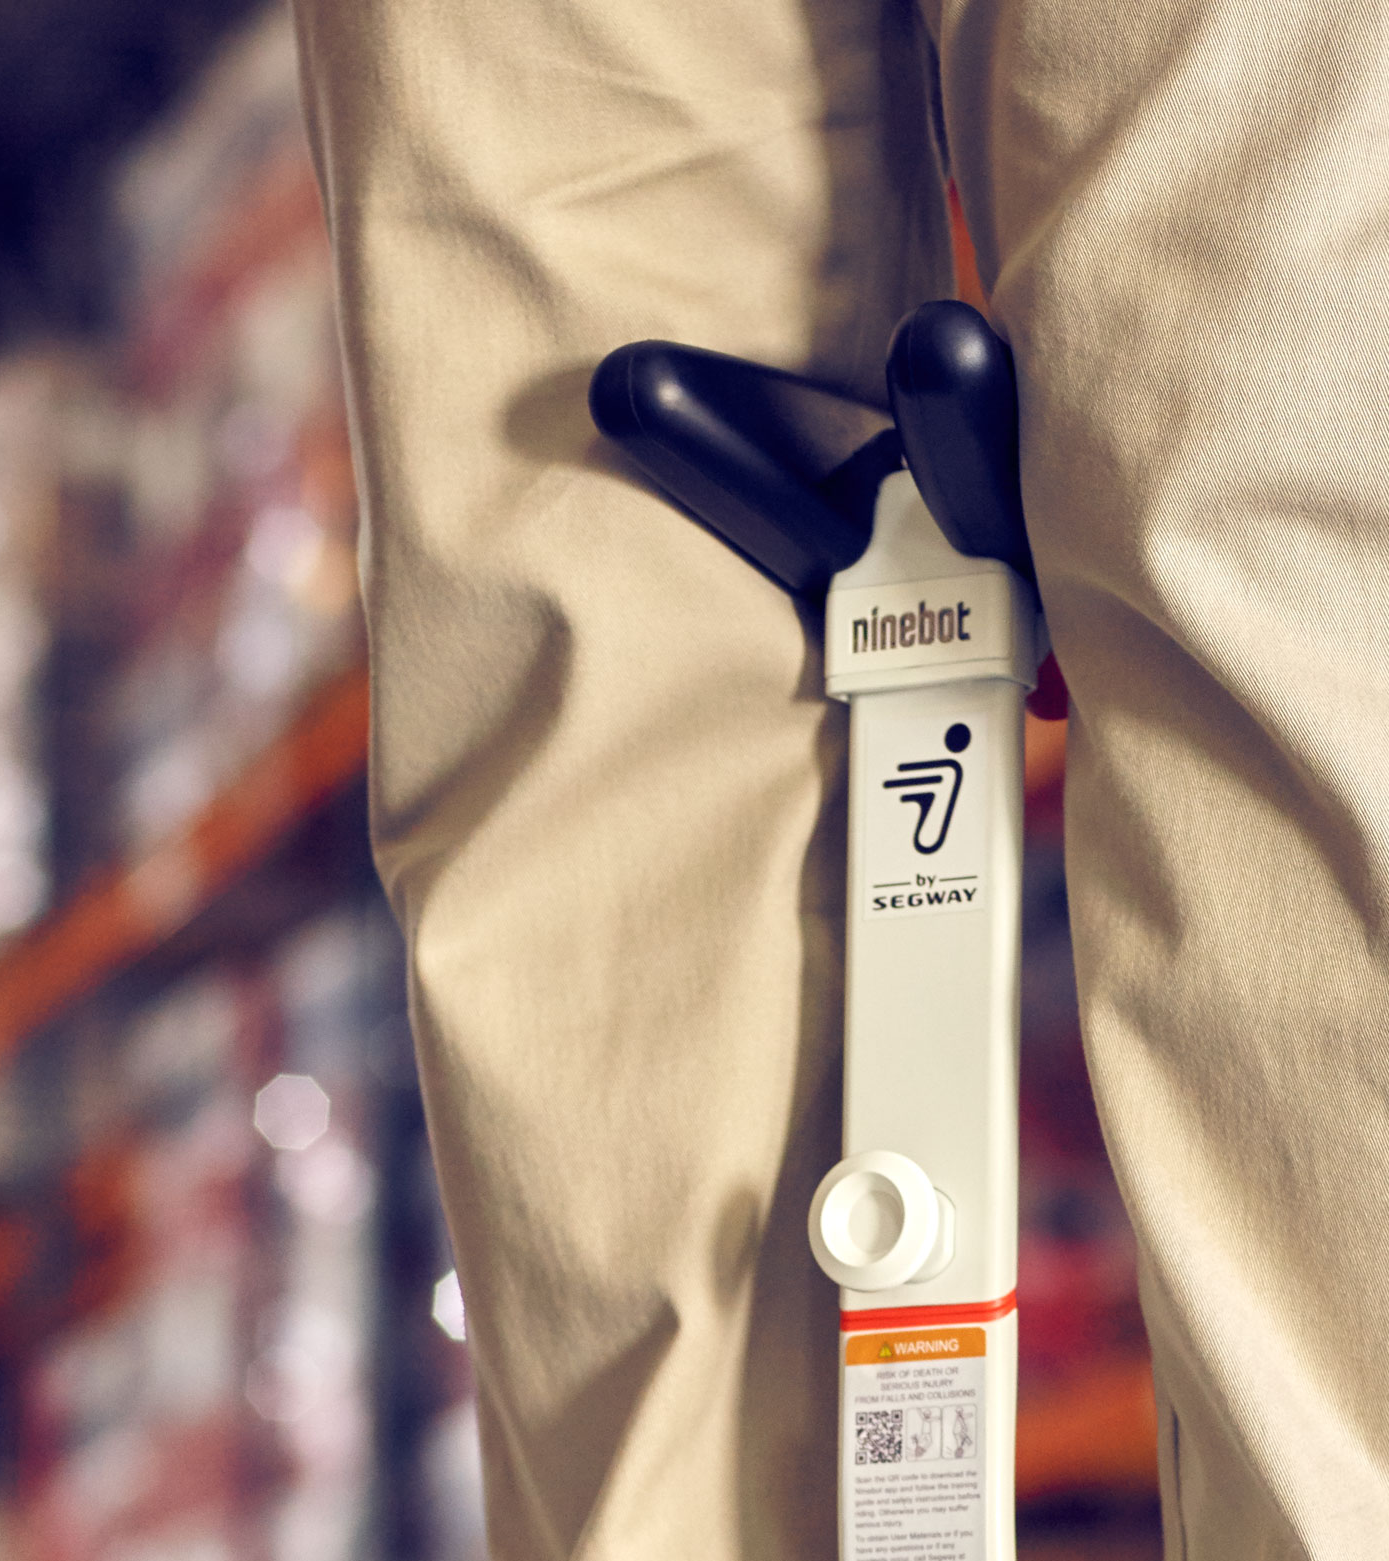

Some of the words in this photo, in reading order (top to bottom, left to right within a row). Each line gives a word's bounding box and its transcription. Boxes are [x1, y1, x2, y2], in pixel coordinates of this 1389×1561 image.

[852, 601, 971, 653] ninebot
[916, 874, 937, 887] by
[873, 887, 978, 910] SEGWAY
[894, 1338, 959, 1355] WARNING
[877, 1371, 895, 1379] RISK
[898, 1370, 909, 1378] OF
[913, 1368, 943, 1377] DEATH
[945, 1367, 958, 1375] OR
[881, 1382, 919, 1391] SERIOUS
[923, 1379, 953, 1388] INJURY
[855, 1396, 878, 1404] FROM
[881, 1394, 906, 1402] FALLS
[908, 1392, 924, 1400] AND
[927, 1389, 976, 1400] COLLISIONS
